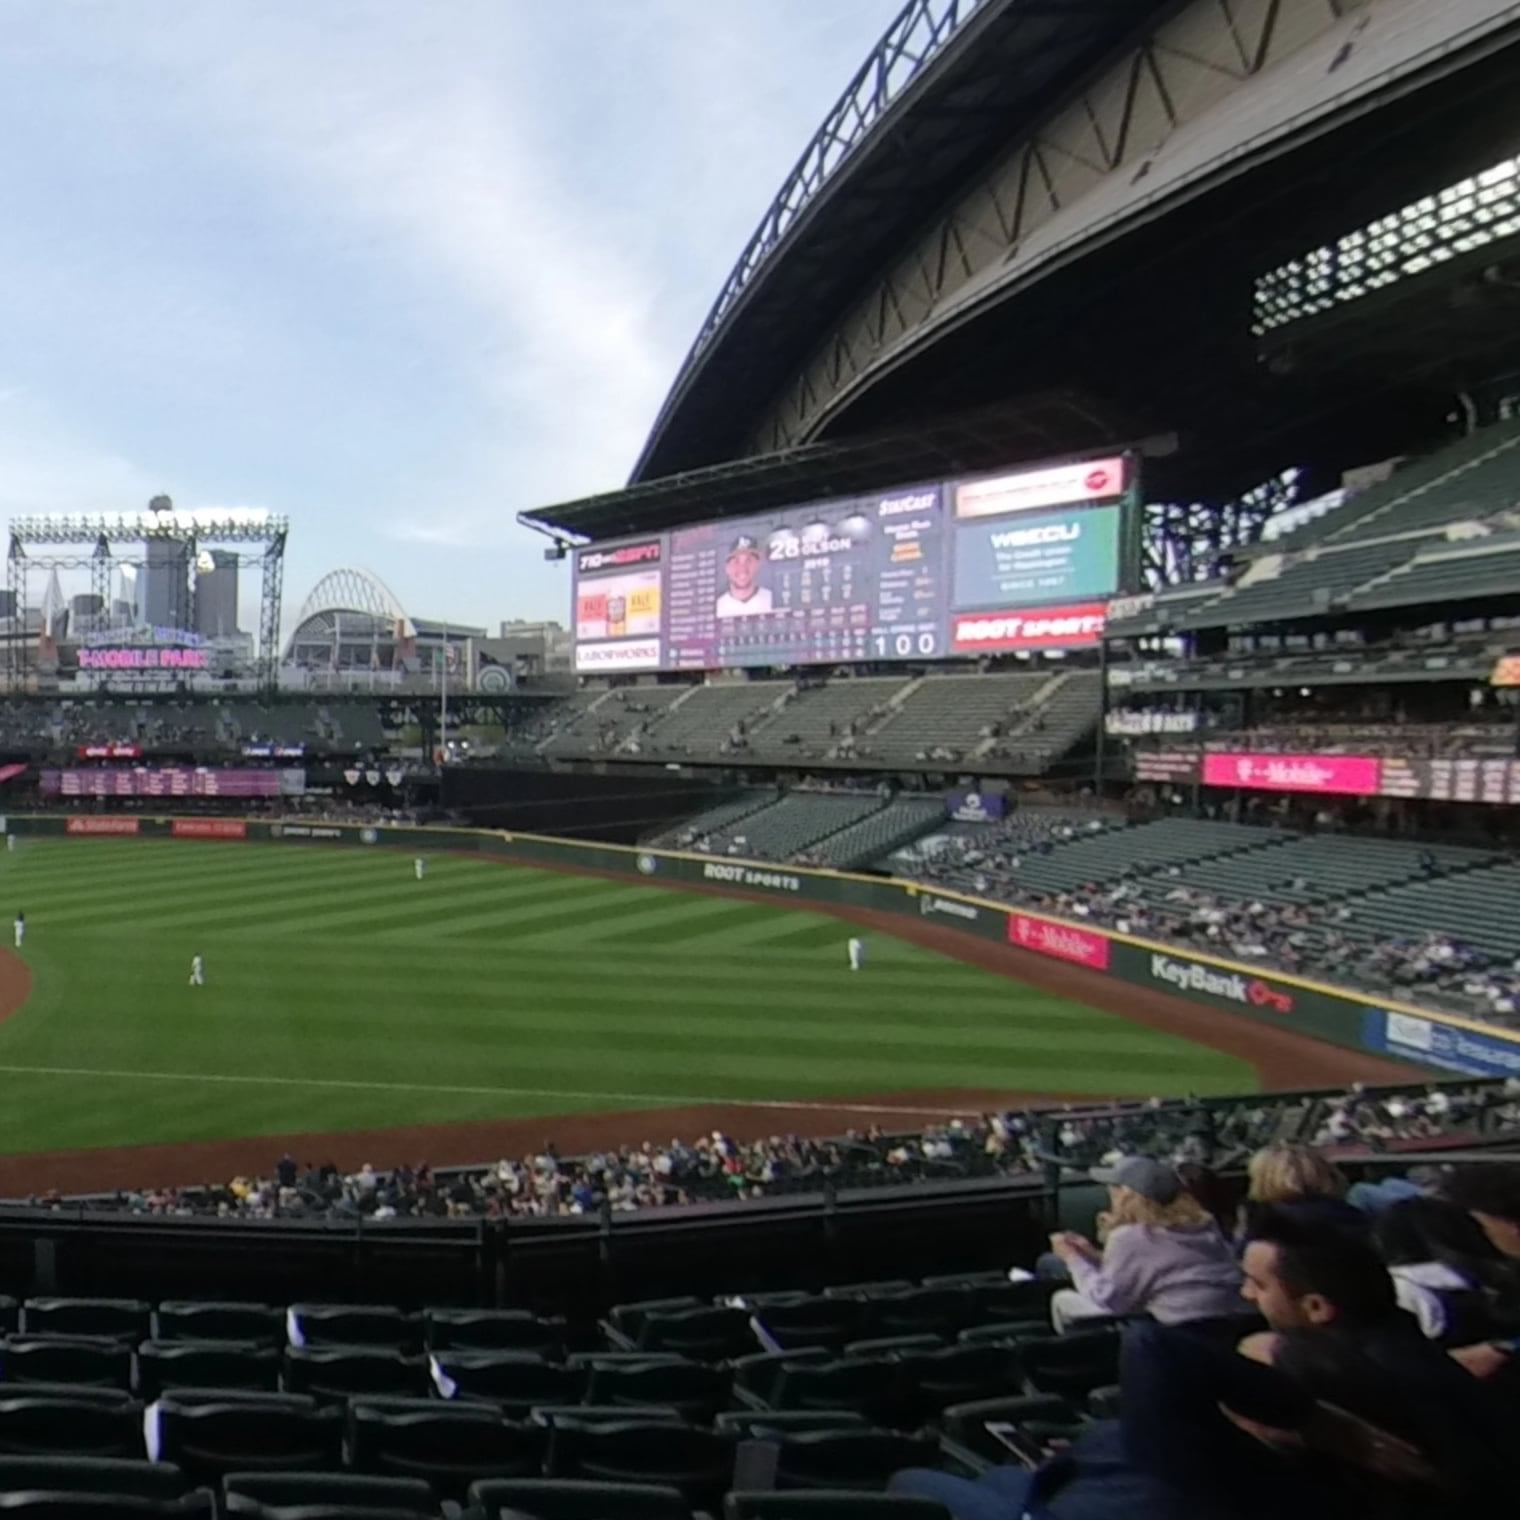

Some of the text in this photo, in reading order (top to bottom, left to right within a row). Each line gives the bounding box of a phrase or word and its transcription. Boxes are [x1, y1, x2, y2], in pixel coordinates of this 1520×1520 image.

[769, 537, 799, 560] 28
[801, 537, 851, 555] OLSON
[580, 552, 602, 570] 710
[956, 617, 1022, 641] ROOT
[875, 636, 886, 656] 1
[896, 635, 911, 656] 0
[918, 633, 934, 654] 0
[77, 649, 210, 668] T-MOBILE PARK
[704, 863, 800, 891] ROOT SPORTS
[1151, 953, 1248, 1002] KeyBank
